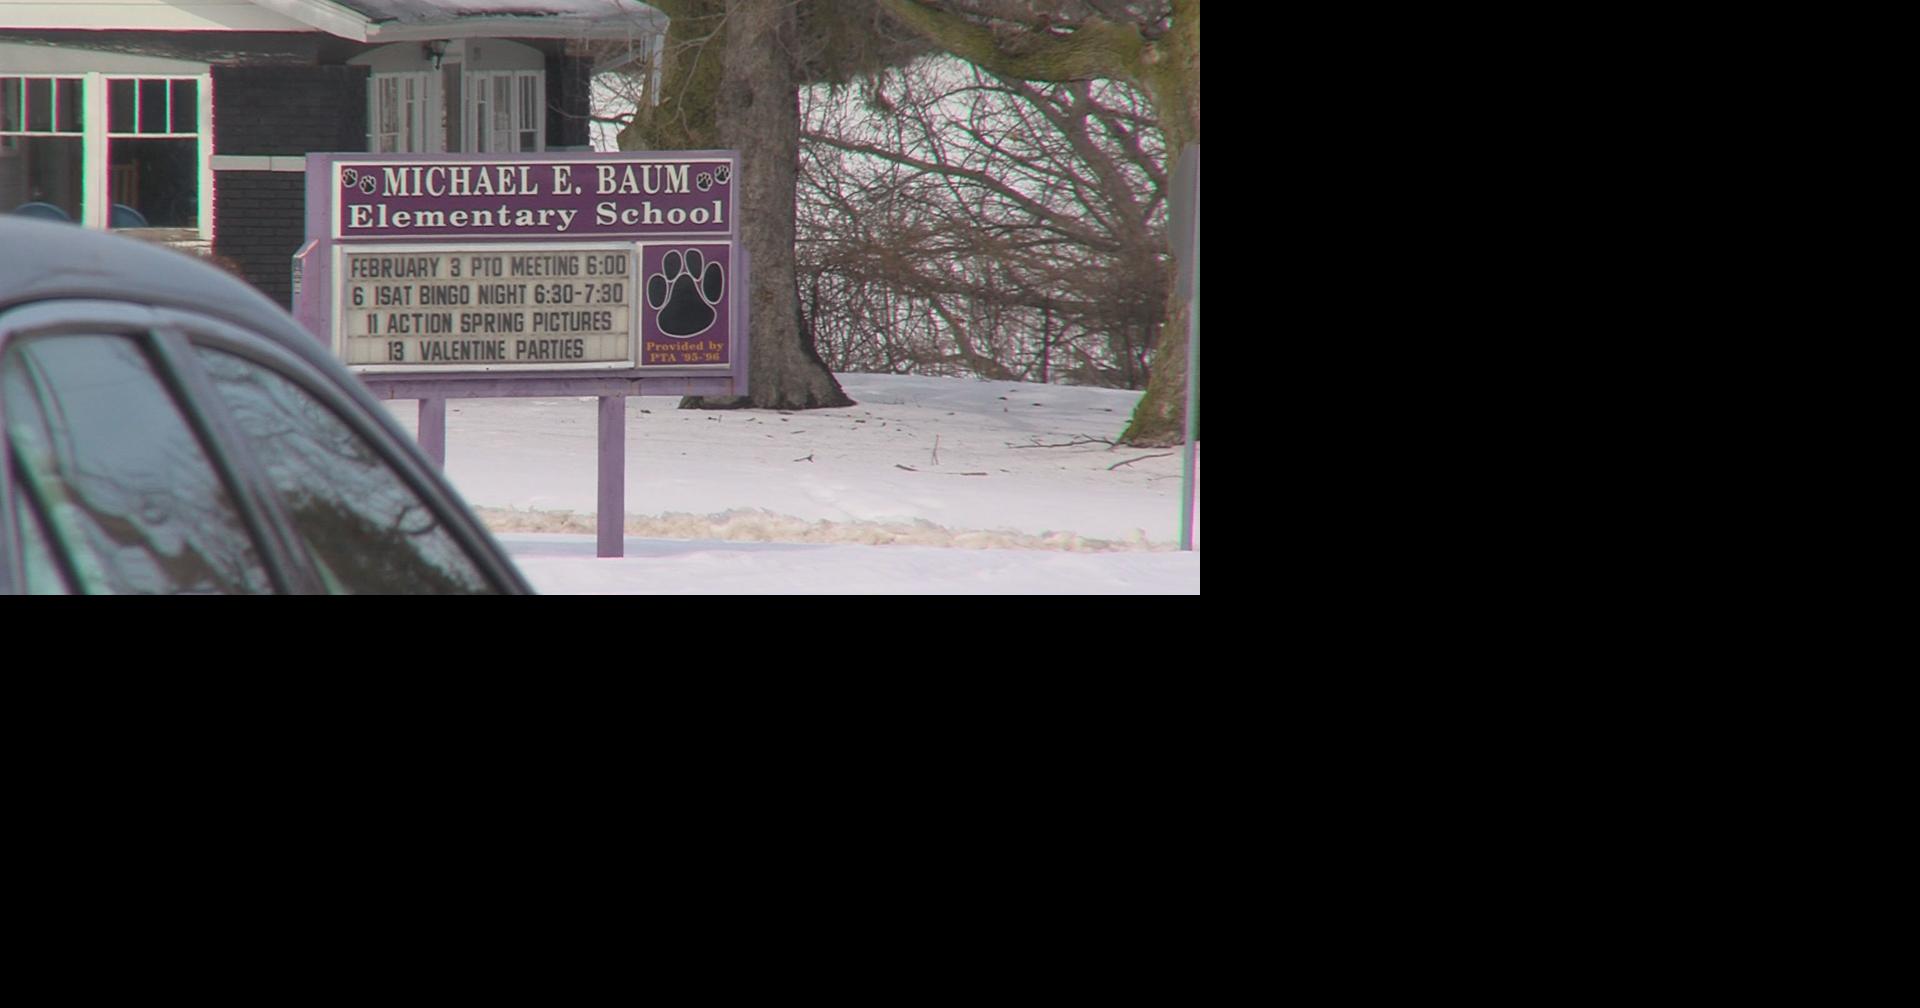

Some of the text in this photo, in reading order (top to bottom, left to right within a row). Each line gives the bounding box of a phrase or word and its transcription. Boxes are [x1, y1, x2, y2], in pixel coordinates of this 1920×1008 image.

[382, 164, 691, 196] MICHAEL E. BAUM
[347, 200, 724, 231] Elementary School
[351, 254, 627, 278] FEBRUARY 3 PTO MEETING 6:00
[352, 283, 624, 306] 6 ISAT BINGO NIGHT 6:30-7:30
[367, 311, 612, 334] 11 ACTION SPRING PICTURES
[388, 338, 584, 361] 13 VALENTINE PARTIES
[646, 341, 723, 352] Provided by
[650, 352, 677, 362] PTA
